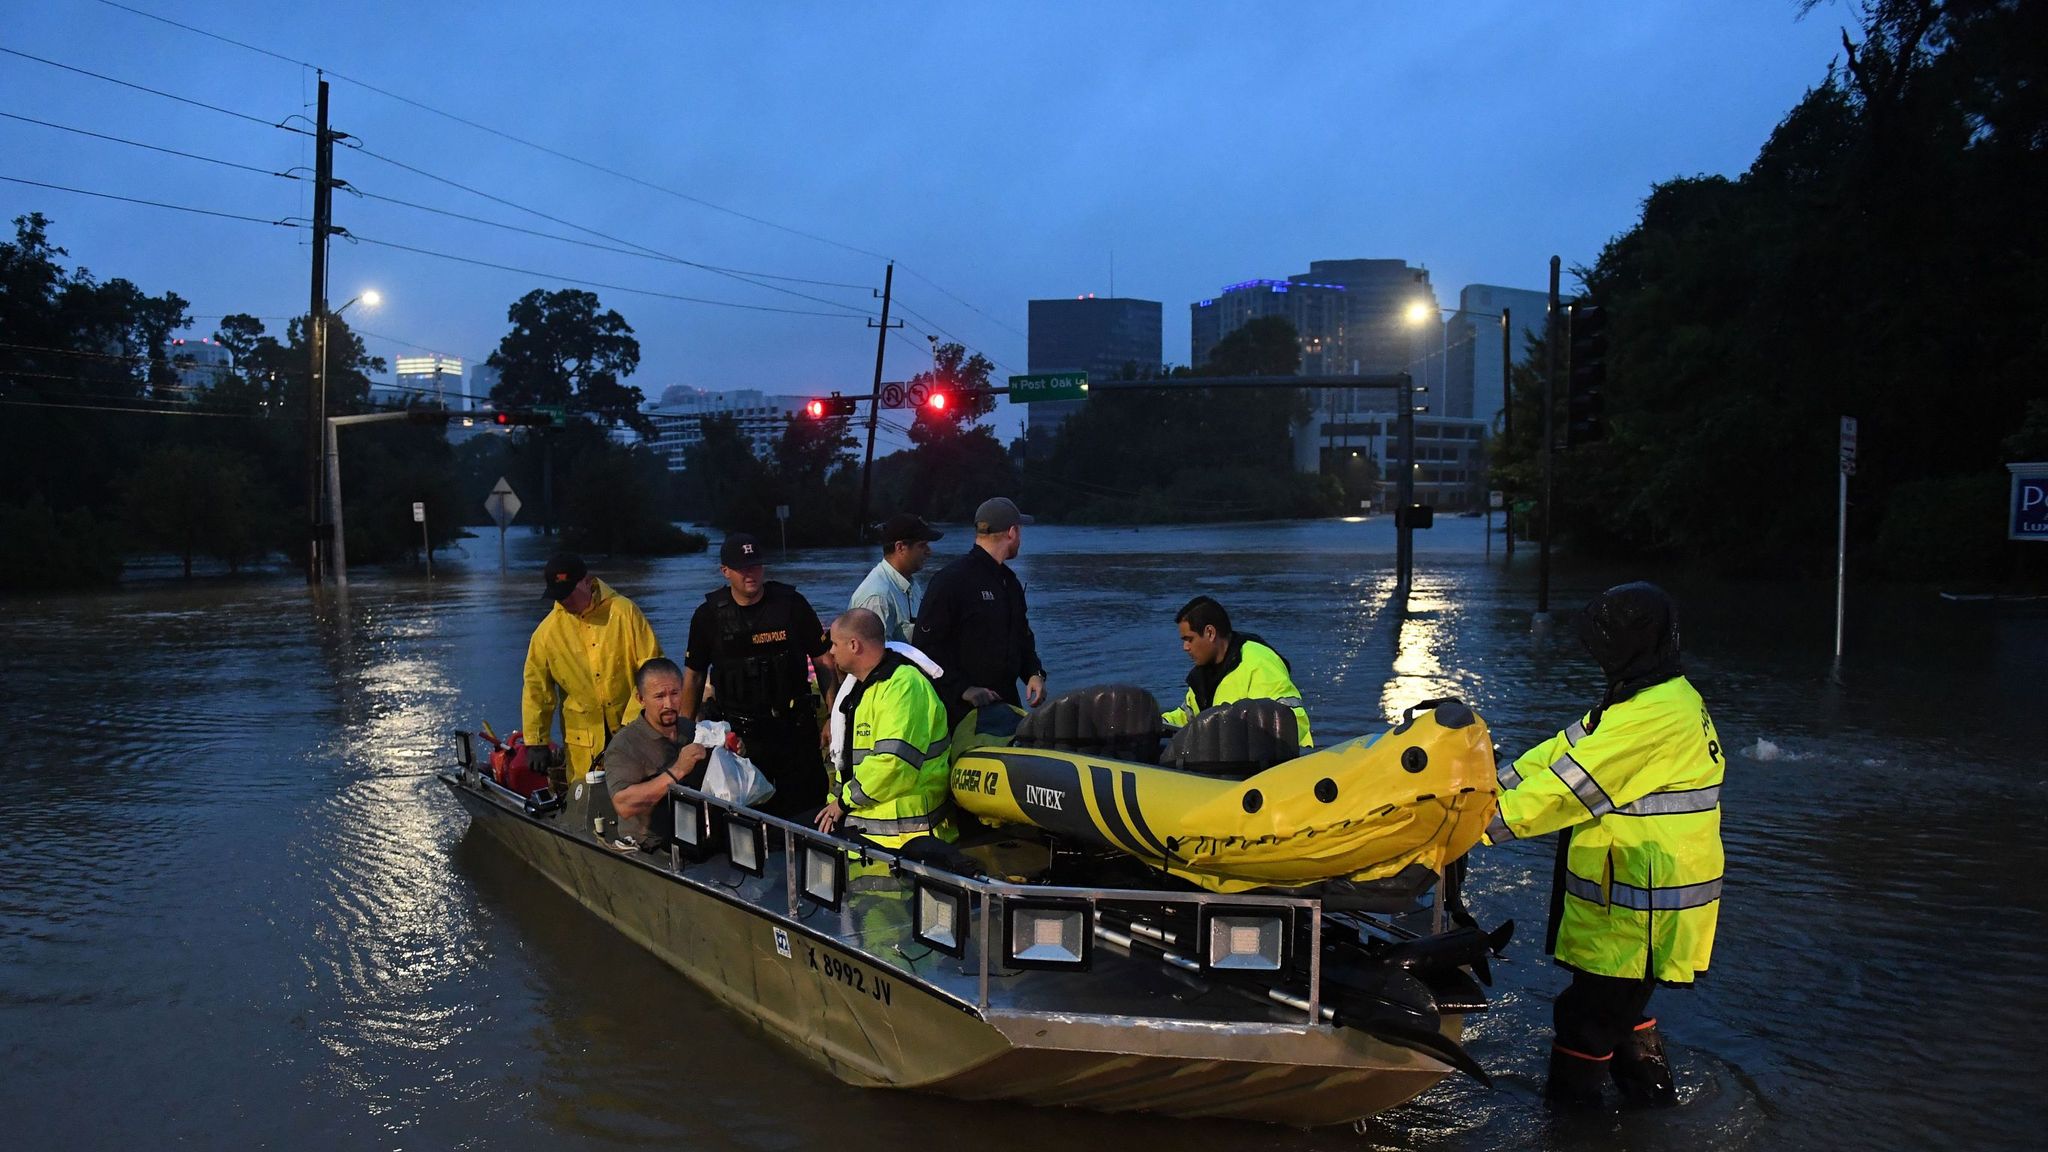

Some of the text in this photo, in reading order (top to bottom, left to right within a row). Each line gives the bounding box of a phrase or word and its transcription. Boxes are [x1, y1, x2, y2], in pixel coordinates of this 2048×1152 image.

[1020, 379, 1046, 390] Post
[1050, 377, 1072, 388] Oak
[742, 543, 754, 554] H
[751, 630, 787, 644] HOUSTON POLICE
[984, 771, 998, 795] K2
[1026, 784, 1062, 811] INTEX
[823, 954, 866, 994] 8992
[872, 976, 890, 1006] JV
